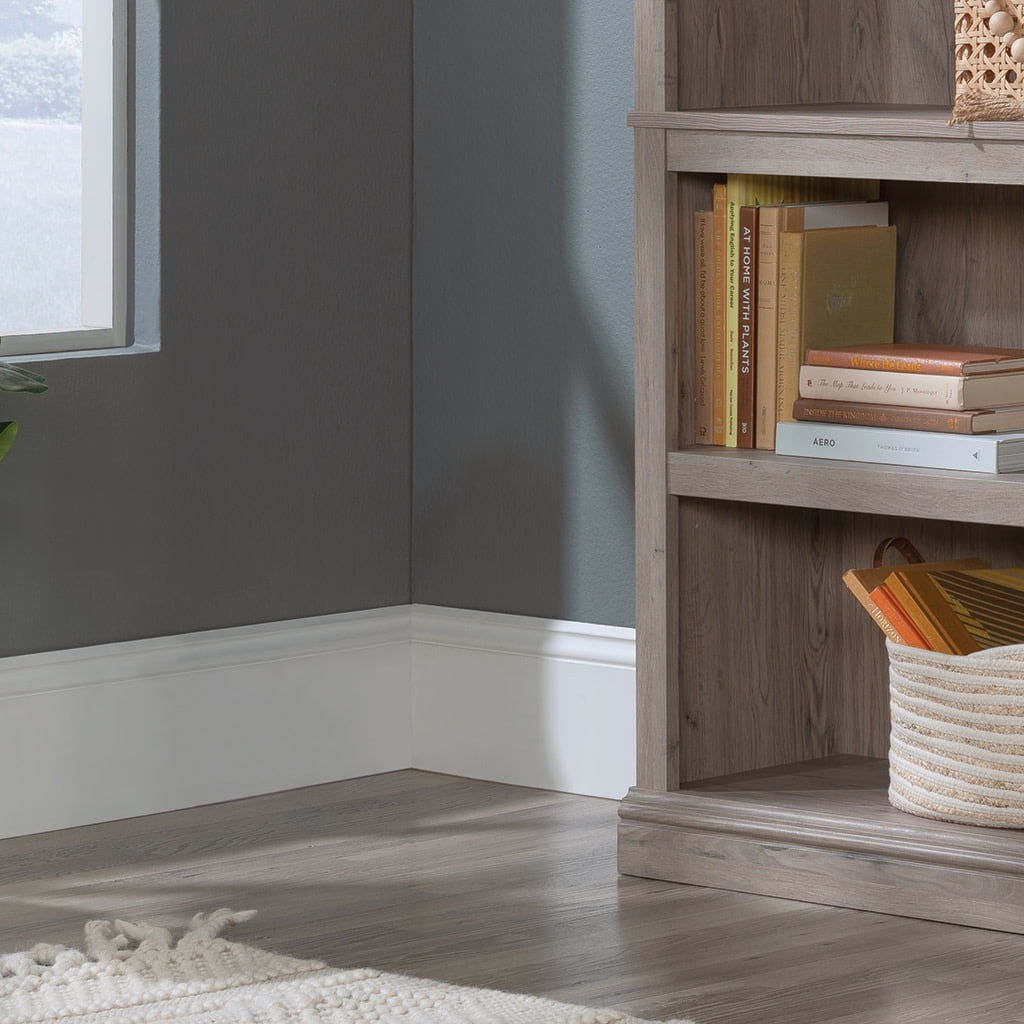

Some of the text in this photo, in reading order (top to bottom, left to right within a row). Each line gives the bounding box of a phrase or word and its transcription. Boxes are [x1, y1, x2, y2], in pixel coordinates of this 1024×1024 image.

[730, 259, 735, 267] to
[741, 226, 751, 374] AT HOME WITH PLANTS
[849, 356, 880, 369] Where
[882, 359, 895, 369] He
[803, 407, 828, 417] INSIDE
[829, 409, 843, 418] THE
[813, 437, 836, 448] AERO
